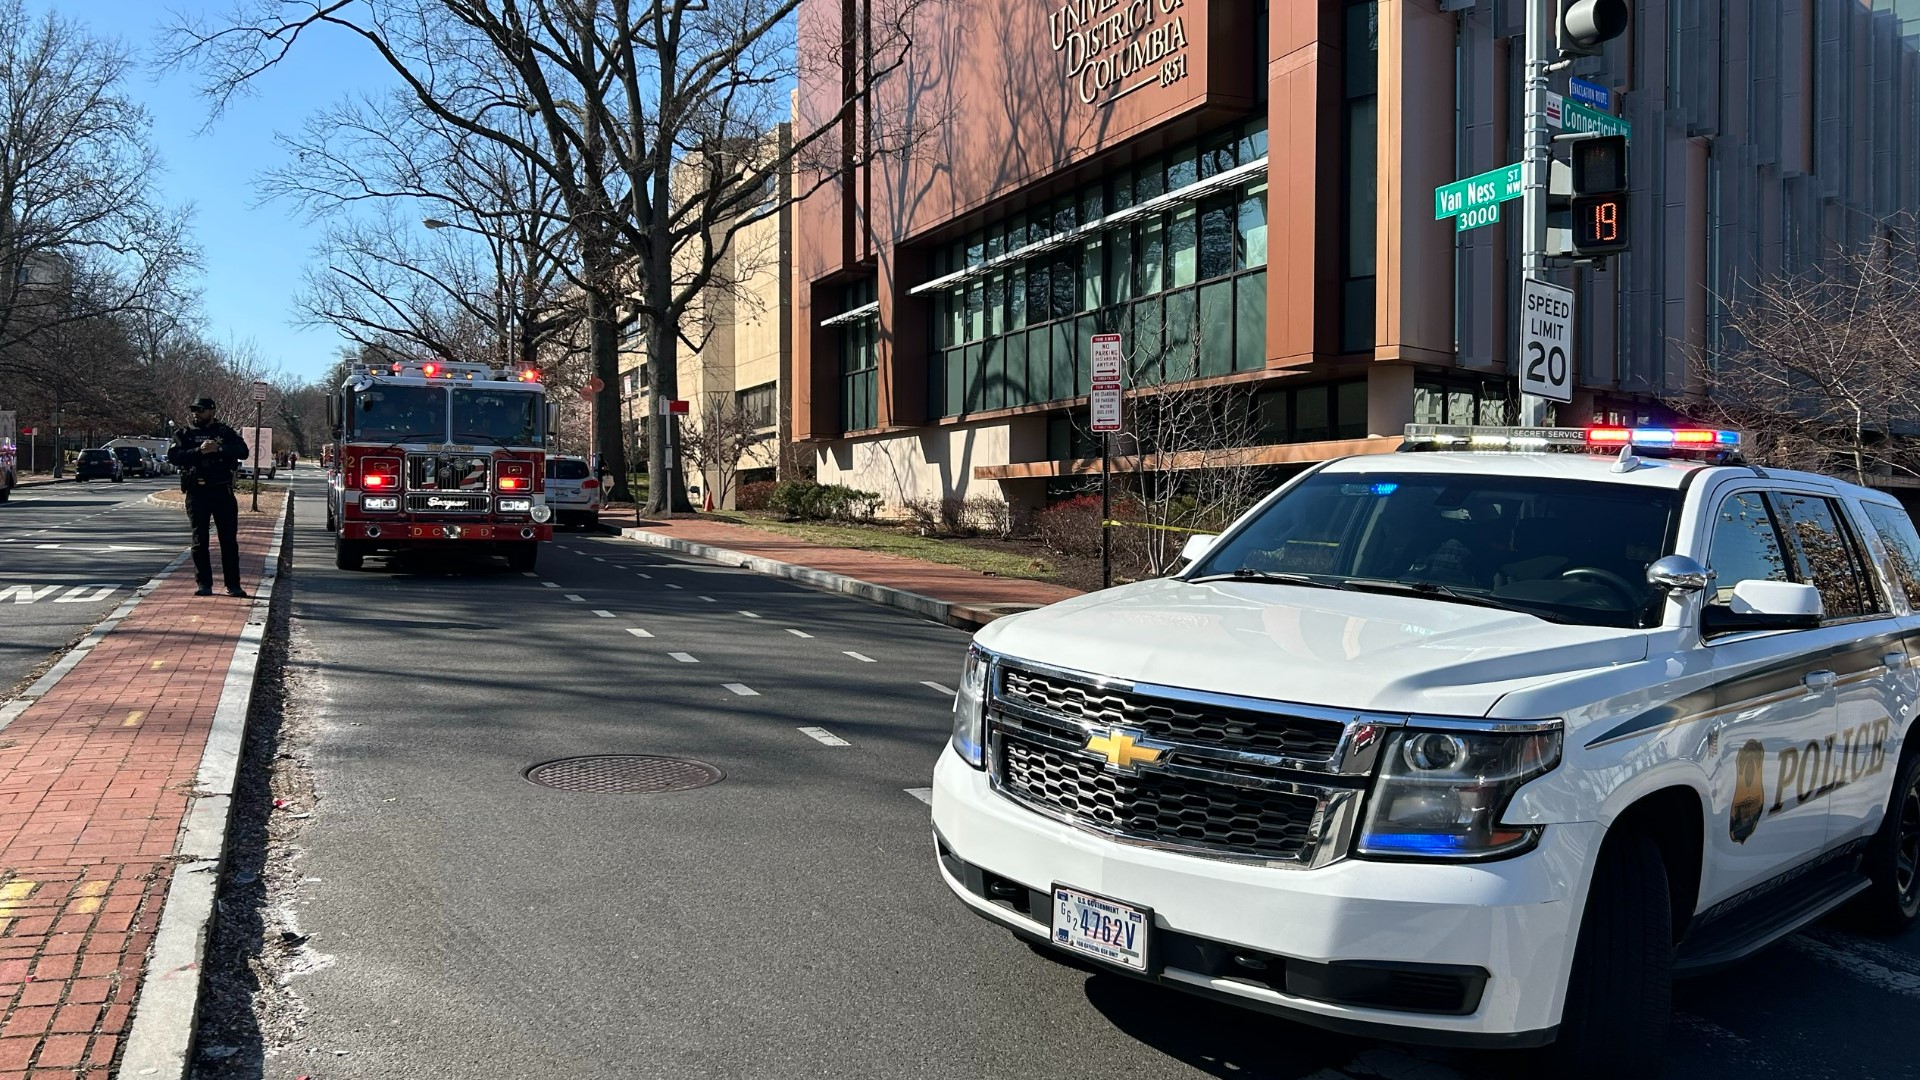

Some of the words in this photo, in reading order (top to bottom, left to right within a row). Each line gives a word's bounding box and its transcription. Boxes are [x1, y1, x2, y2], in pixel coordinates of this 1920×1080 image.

[1067, 0, 1153, 78] DISTRICT
[1079, 16, 1187, 104] COLUMBIA
[1159, 54, 1187, 87] 1851
[1565, 103, 1617, 137] Connecticut
[1506, 180, 1521, 195] NW
[1507, 169, 1519, 182] ST
[1440, 190, 1462, 213] Van
[1467, 182, 1496, 206] Ness
[1460, 204, 1497, 229] 3000
[1595, 203, 1617, 241] 19
[1527, 293, 1569, 319] SPEED
[1531, 318, 1564, 341] LIMIT
[1526, 341, 1566, 387] 20
[1513, 429, 1547, 437] SECRET
[1547, 430, 1584, 439] SERVICE
[1767, 716, 1890, 817] POLICE
[1087, 898, 1119, 915] GOVERNMENT
[1079, 908, 1136, 950] 4762V
